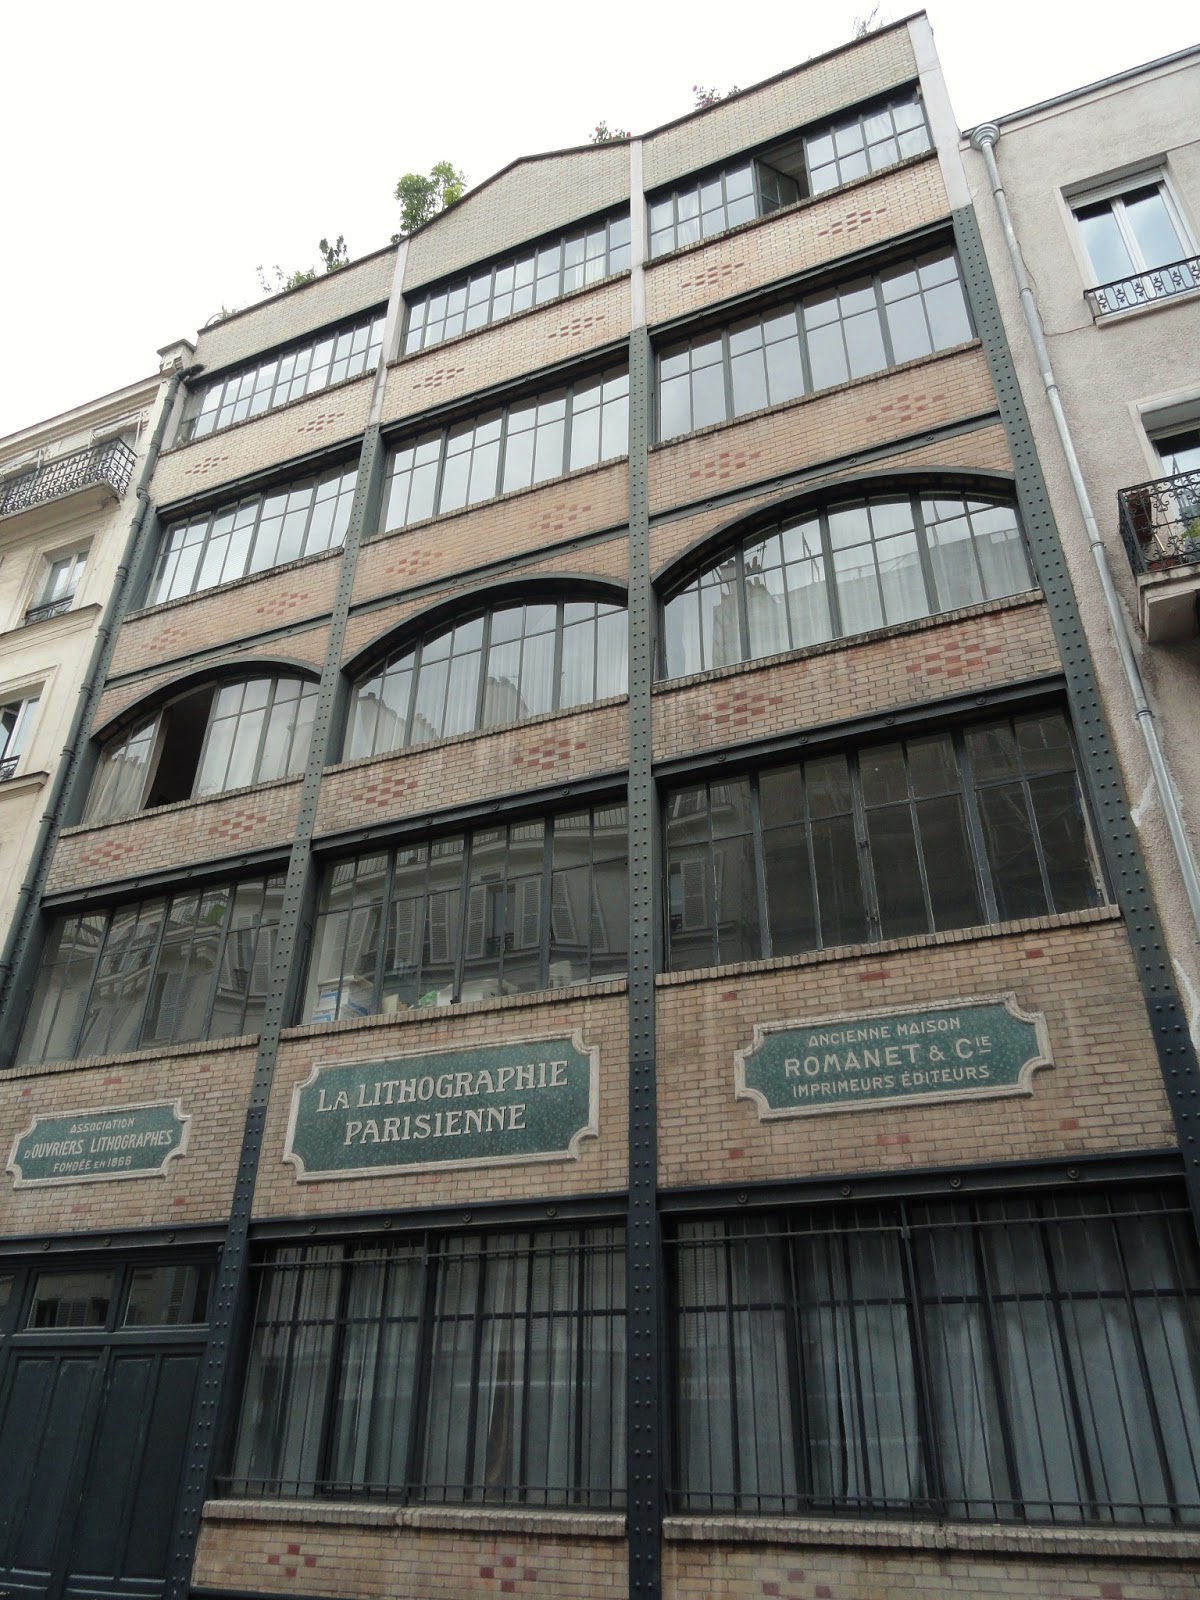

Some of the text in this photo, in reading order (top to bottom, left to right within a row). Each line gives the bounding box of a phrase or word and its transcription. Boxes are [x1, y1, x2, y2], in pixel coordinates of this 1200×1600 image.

[808, 1017, 961, 1047] ANCIENNE MAISON
[784, 1043, 921, 1078] ROMANET
[929, 1045, 946, 1062] &
[316, 1060, 568, 1112] LA LITHOGRAPHIE
[792, 1065, 990, 1098] IMPRIMEURS ÉDITEURS
[70, 1118, 135, 1133] ASSOCIATION
[343, 1104, 526, 1146] PARISIENNE
[90, 1129, 173, 1153] LITHOGRAPHES
[53, 1159, 91, 1173] FONDÉE
[107, 1156, 132, 1167] 1866
